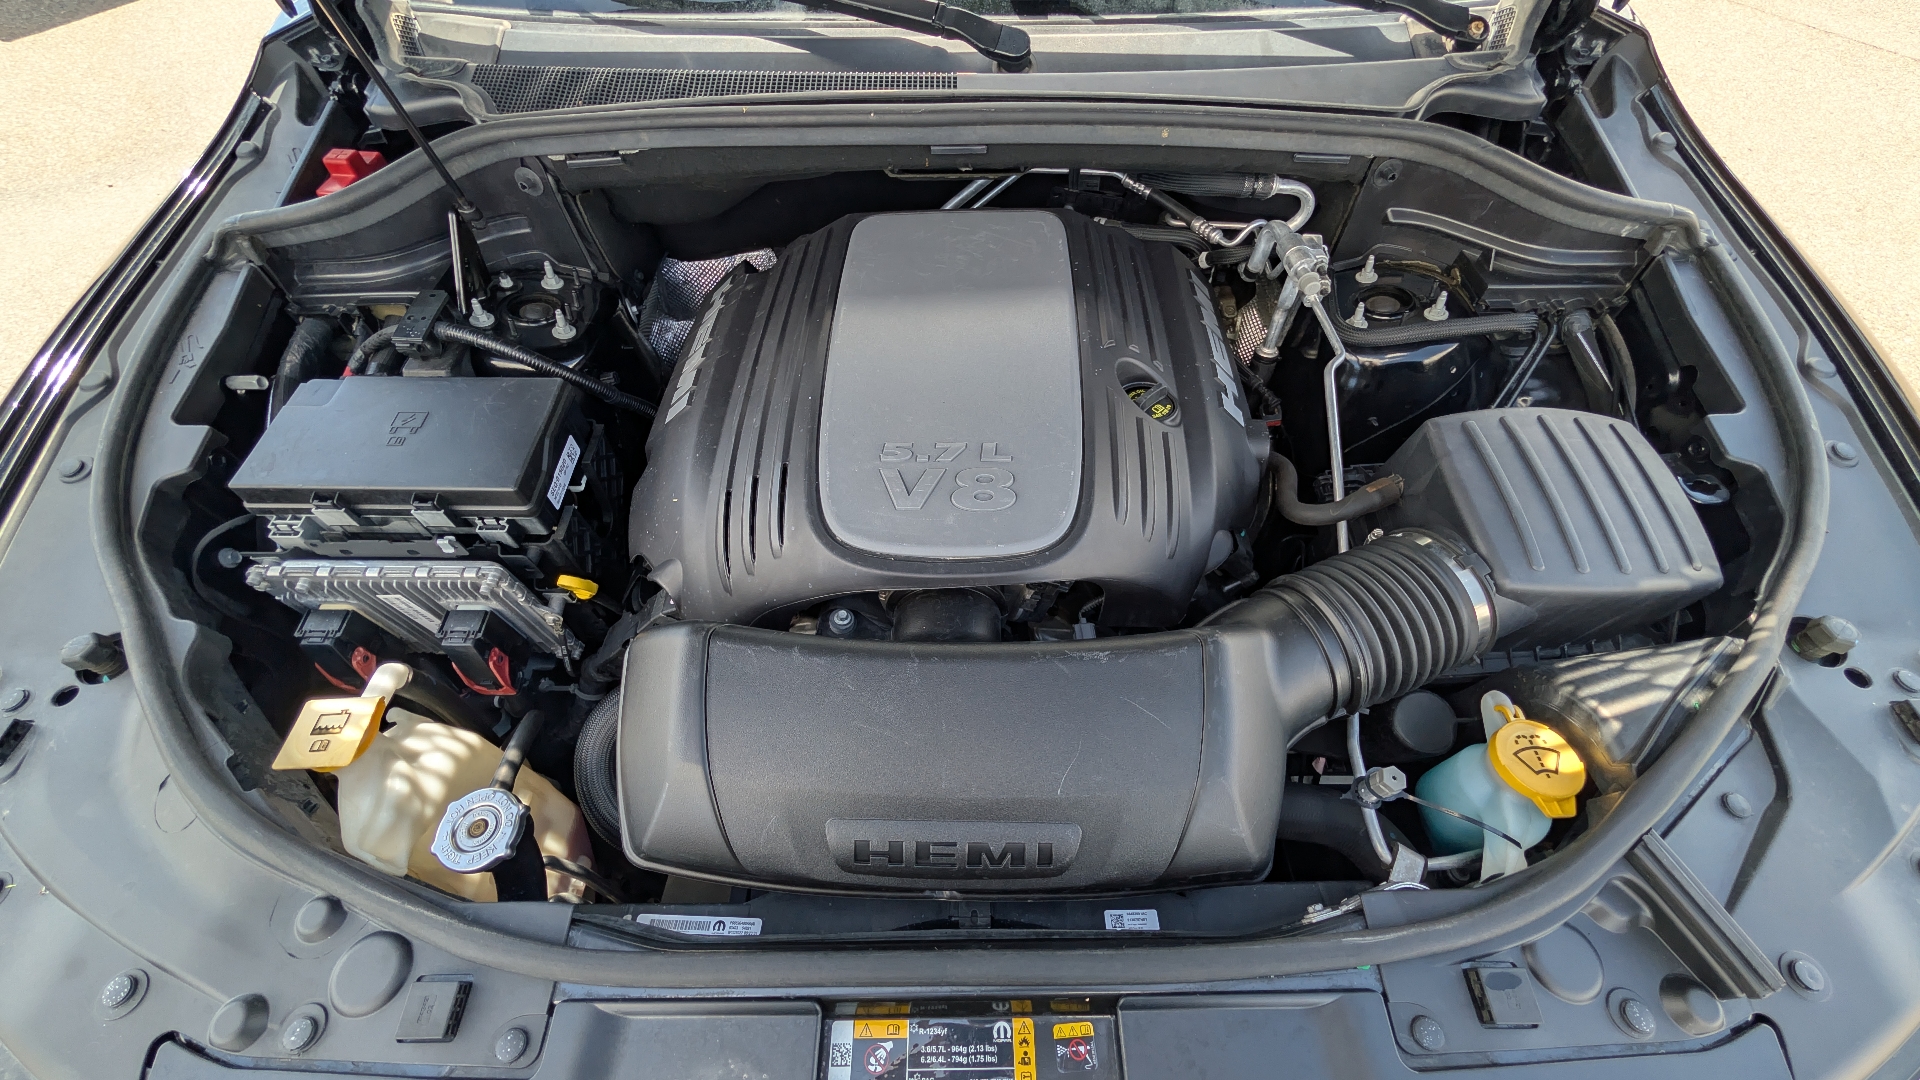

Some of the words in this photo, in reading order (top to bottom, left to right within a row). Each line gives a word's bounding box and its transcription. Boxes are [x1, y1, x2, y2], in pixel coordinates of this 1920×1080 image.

[879, 442, 968, 462] 5.7
[980, 442, 1013, 462] L
[878, 467, 1017, 512] V8
[466, 791, 496, 807] OPEN
[496, 795, 513, 813] NOT
[446, 804, 465, 826] HOT
[504, 812, 514, 827] DO
[441, 843, 462, 865] TIGHT
[466, 843, 498, 865] KEEP
[853, 839, 1054, 869] HEMI
[919, 1027, 948, 1036] R-1234yf
[920, 1045, 946, 1053] 3.6/5.7L
[951, 1045, 967, 1054] 964g
[968, 1045, 984, 1054] (2.13
[985, 1044, 998, 1053] lbs)
[920, 1055, 946, 1064] 6.2/6.4L
[951, 1055, 967, 1064] 794g
[968, 1055, 984, 1064] (1.75
[985, 1054, 998, 1063] lbs)
